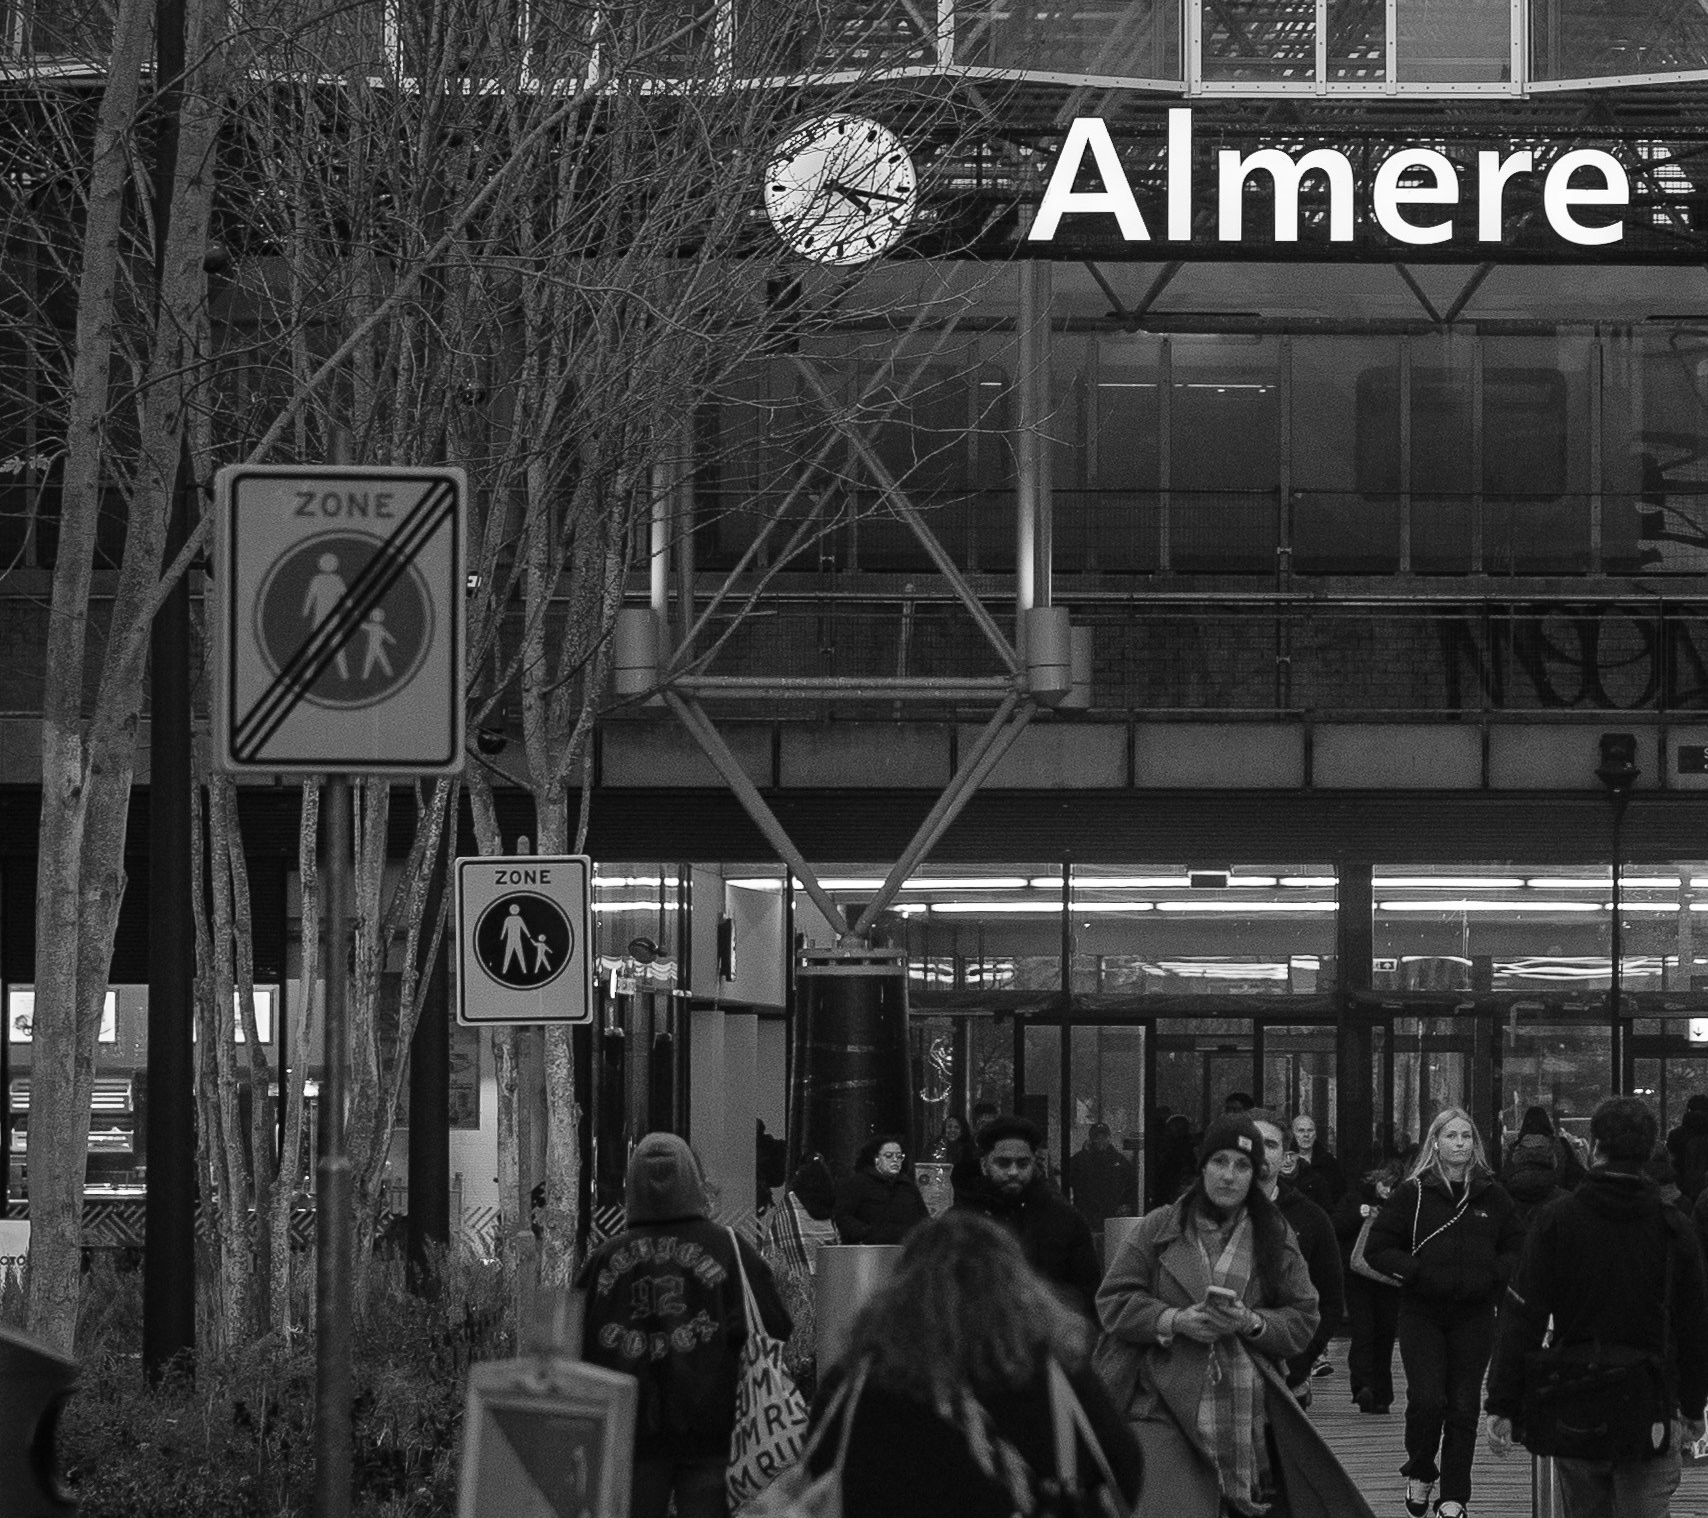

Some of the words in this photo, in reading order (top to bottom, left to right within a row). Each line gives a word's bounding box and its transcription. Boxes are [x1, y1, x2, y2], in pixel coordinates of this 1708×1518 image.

[1028, 108, 1630, 245] Almere
[295, 491, 396, 518] ZONE
[494, 869, 552, 885] ZONE
